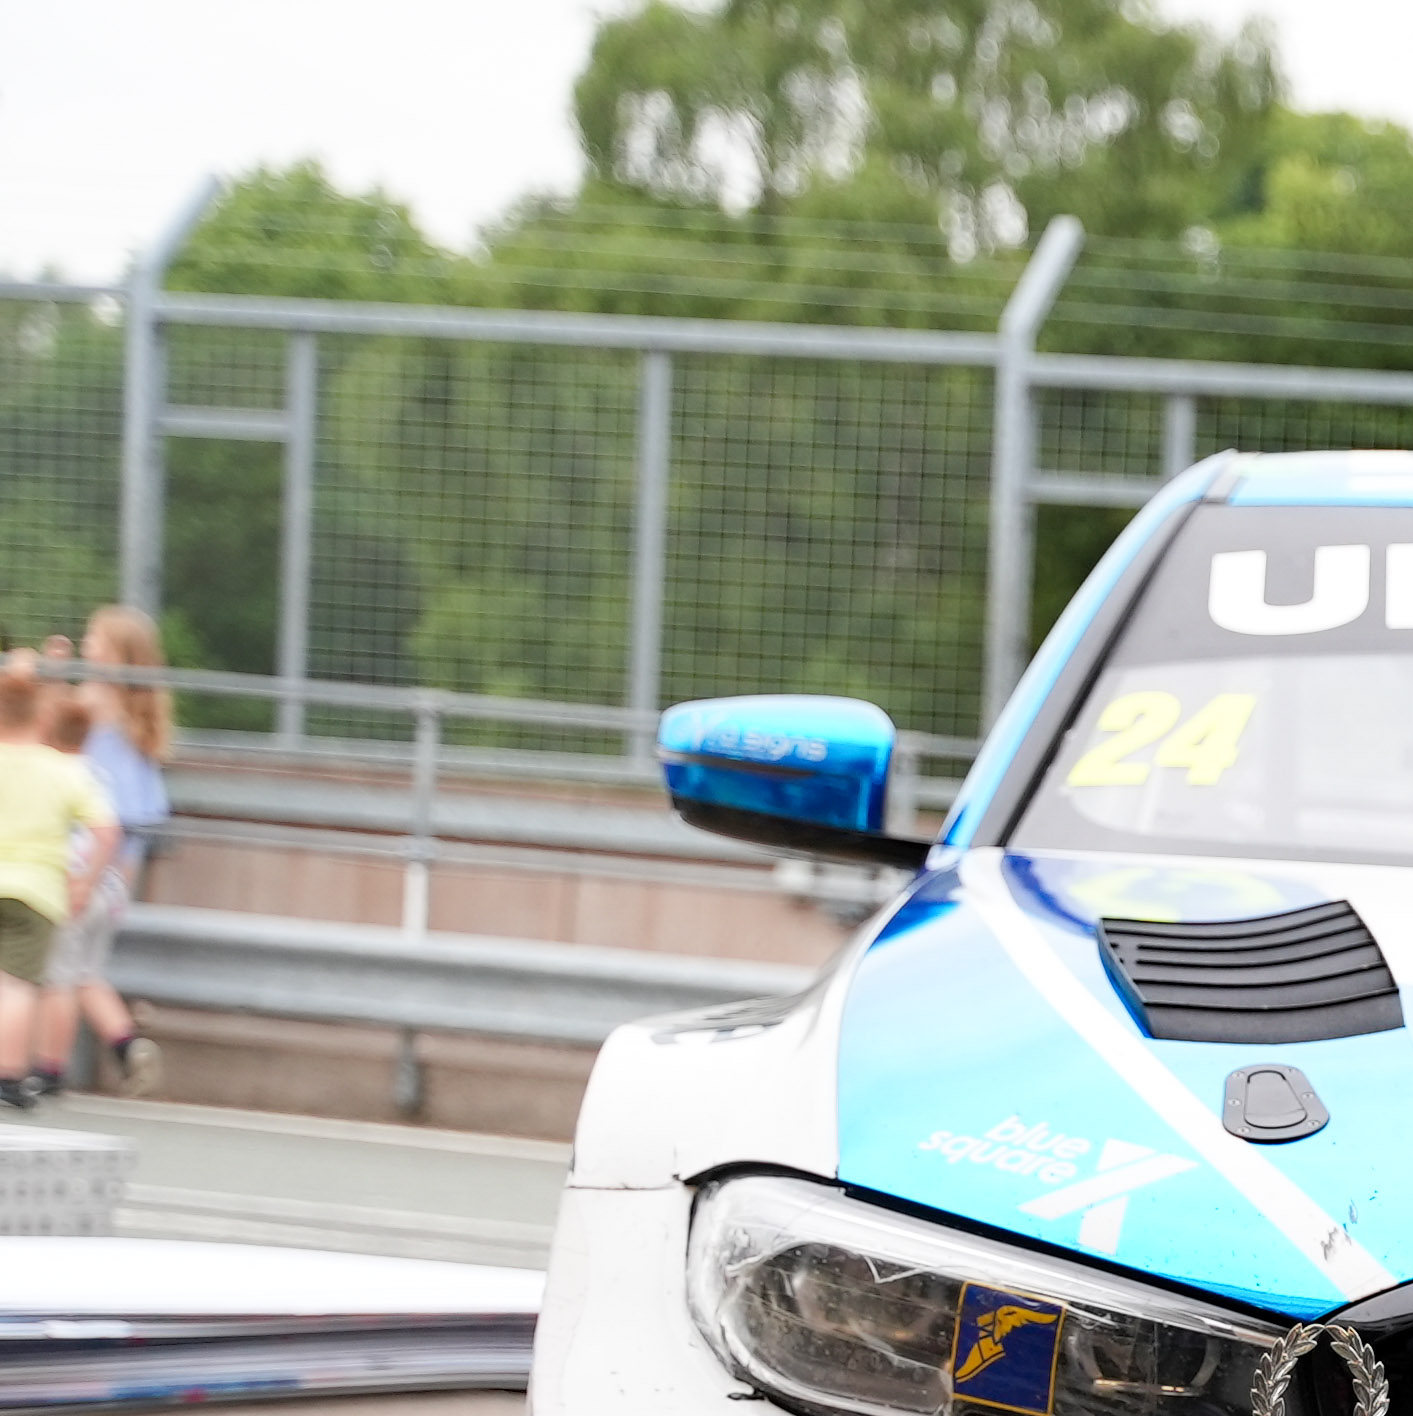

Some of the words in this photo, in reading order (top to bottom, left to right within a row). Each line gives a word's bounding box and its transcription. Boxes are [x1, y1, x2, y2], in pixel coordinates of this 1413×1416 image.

[1067, 690, 1256, 787] 24
[917, 1130, 1077, 1184] square
[984, 1113, 1091, 1160] blue
